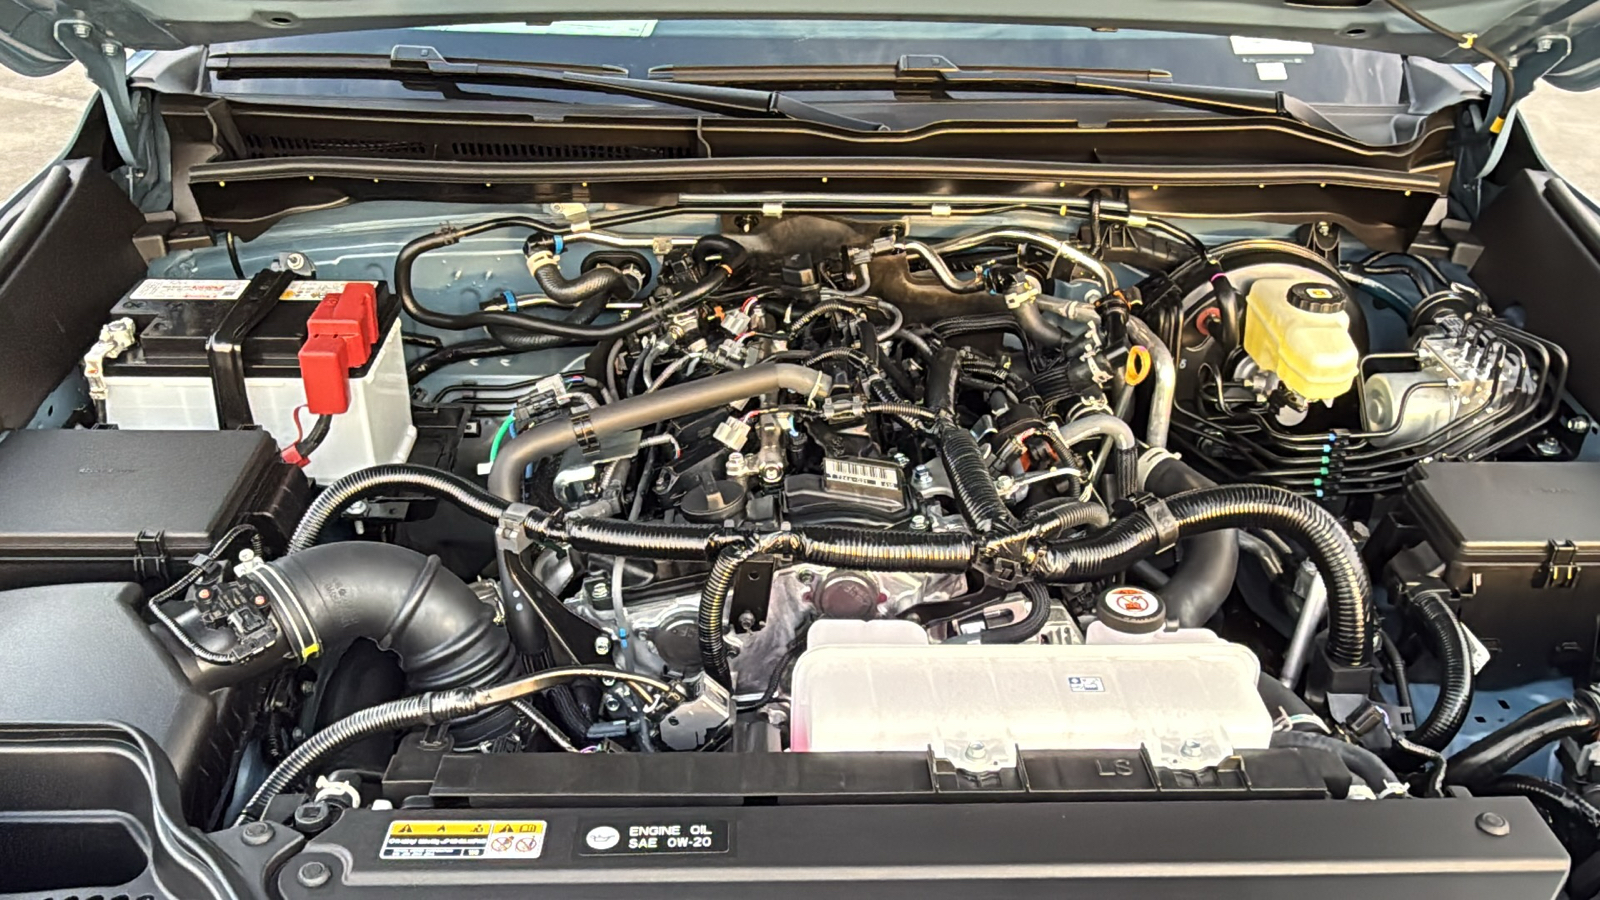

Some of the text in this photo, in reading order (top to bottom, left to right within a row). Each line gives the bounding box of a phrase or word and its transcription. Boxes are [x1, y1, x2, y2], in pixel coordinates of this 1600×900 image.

[1095, 759, 1133, 776] LS
[629, 824, 713, 837] ENGINE OIL
[628, 836, 712, 849] SAE 0W-20
